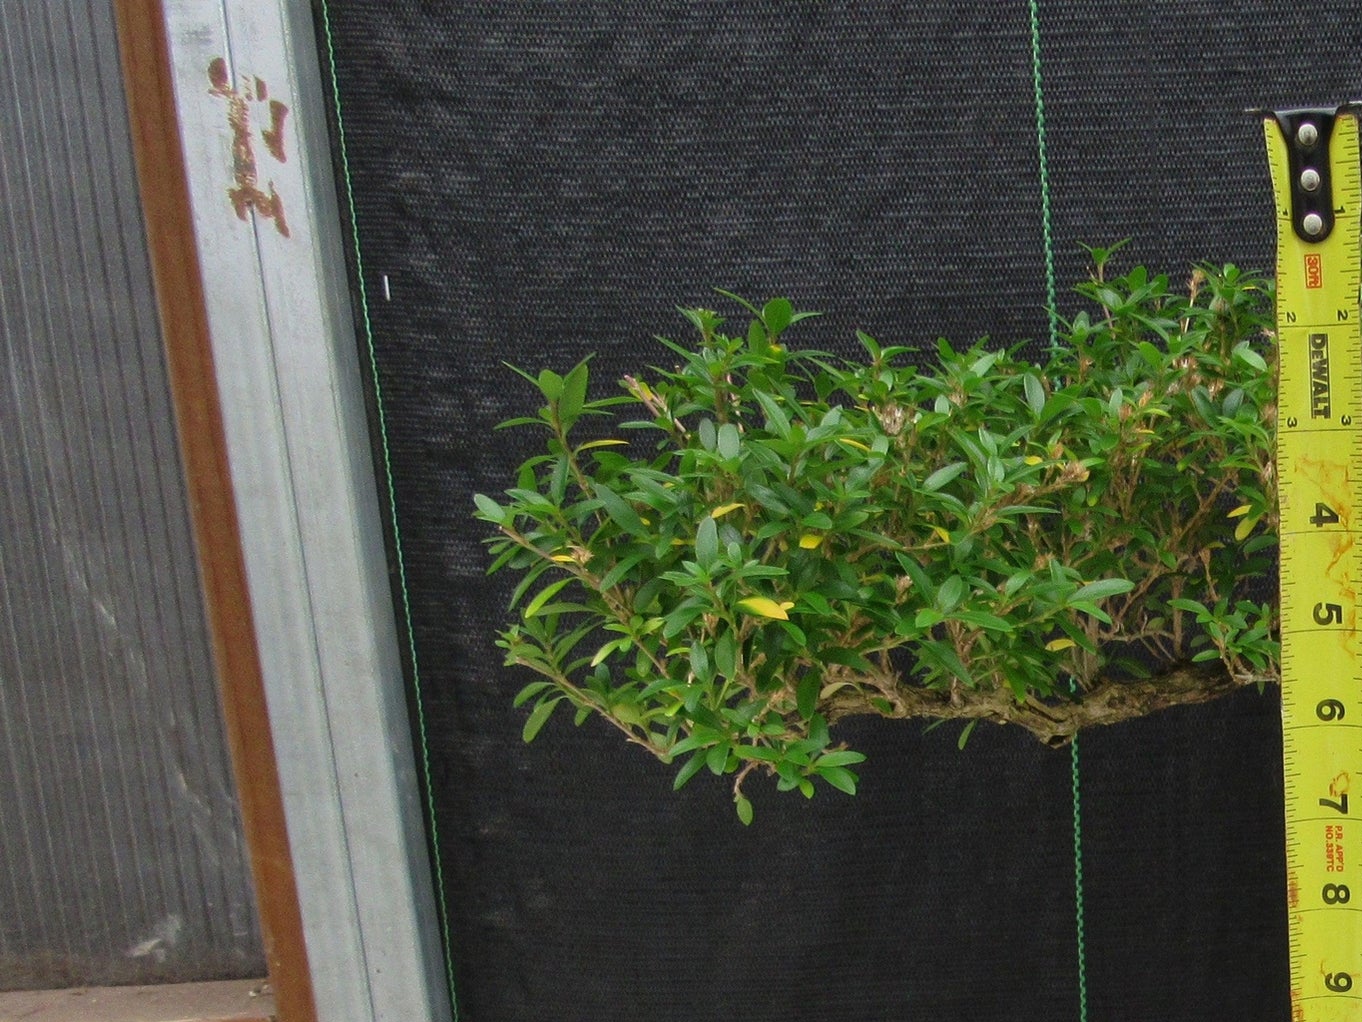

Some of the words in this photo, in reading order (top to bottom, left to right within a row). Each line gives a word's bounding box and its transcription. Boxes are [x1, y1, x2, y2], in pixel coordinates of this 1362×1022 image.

[1335, 206, 1346, 214] 1
[1286, 312, 1297, 323] 2
[1337, 310, 1348, 321] 2
[1310, 334, 1331, 419] DEWALT
[1287, 417, 1297, 428] 3
[1341, 415, 1352, 426] 3
[1310, 503, 1340, 527] 4
[1313, 602, 1343, 626] 5
[1316, 699, 1345, 721] 6
[1319, 793, 1348, 815] 7
[1322, 883, 1350, 905] 8
[1325, 972, 1353, 992] 9
